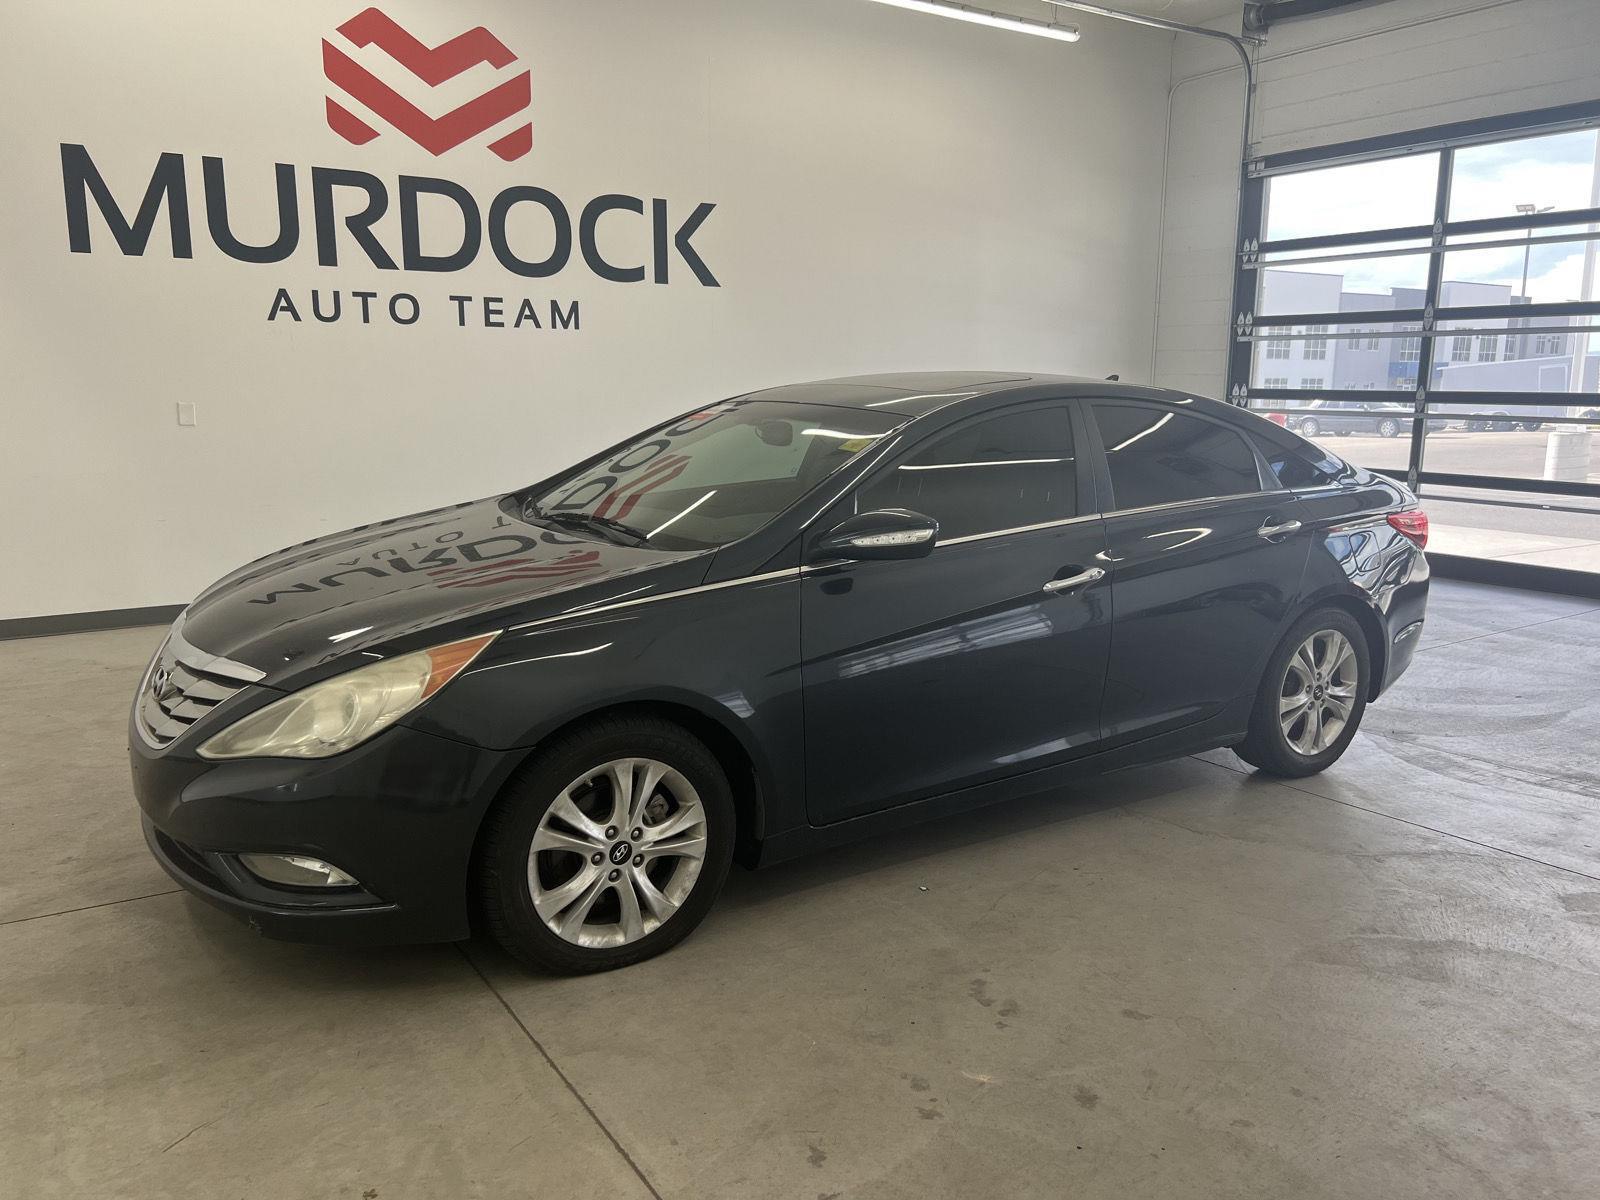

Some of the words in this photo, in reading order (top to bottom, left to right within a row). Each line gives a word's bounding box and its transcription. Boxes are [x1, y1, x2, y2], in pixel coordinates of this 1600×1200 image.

[60, 142, 722, 288] MURDOCK
[267, 288, 420, 325] AUTO
[449, 294, 580, 330] TEAM
